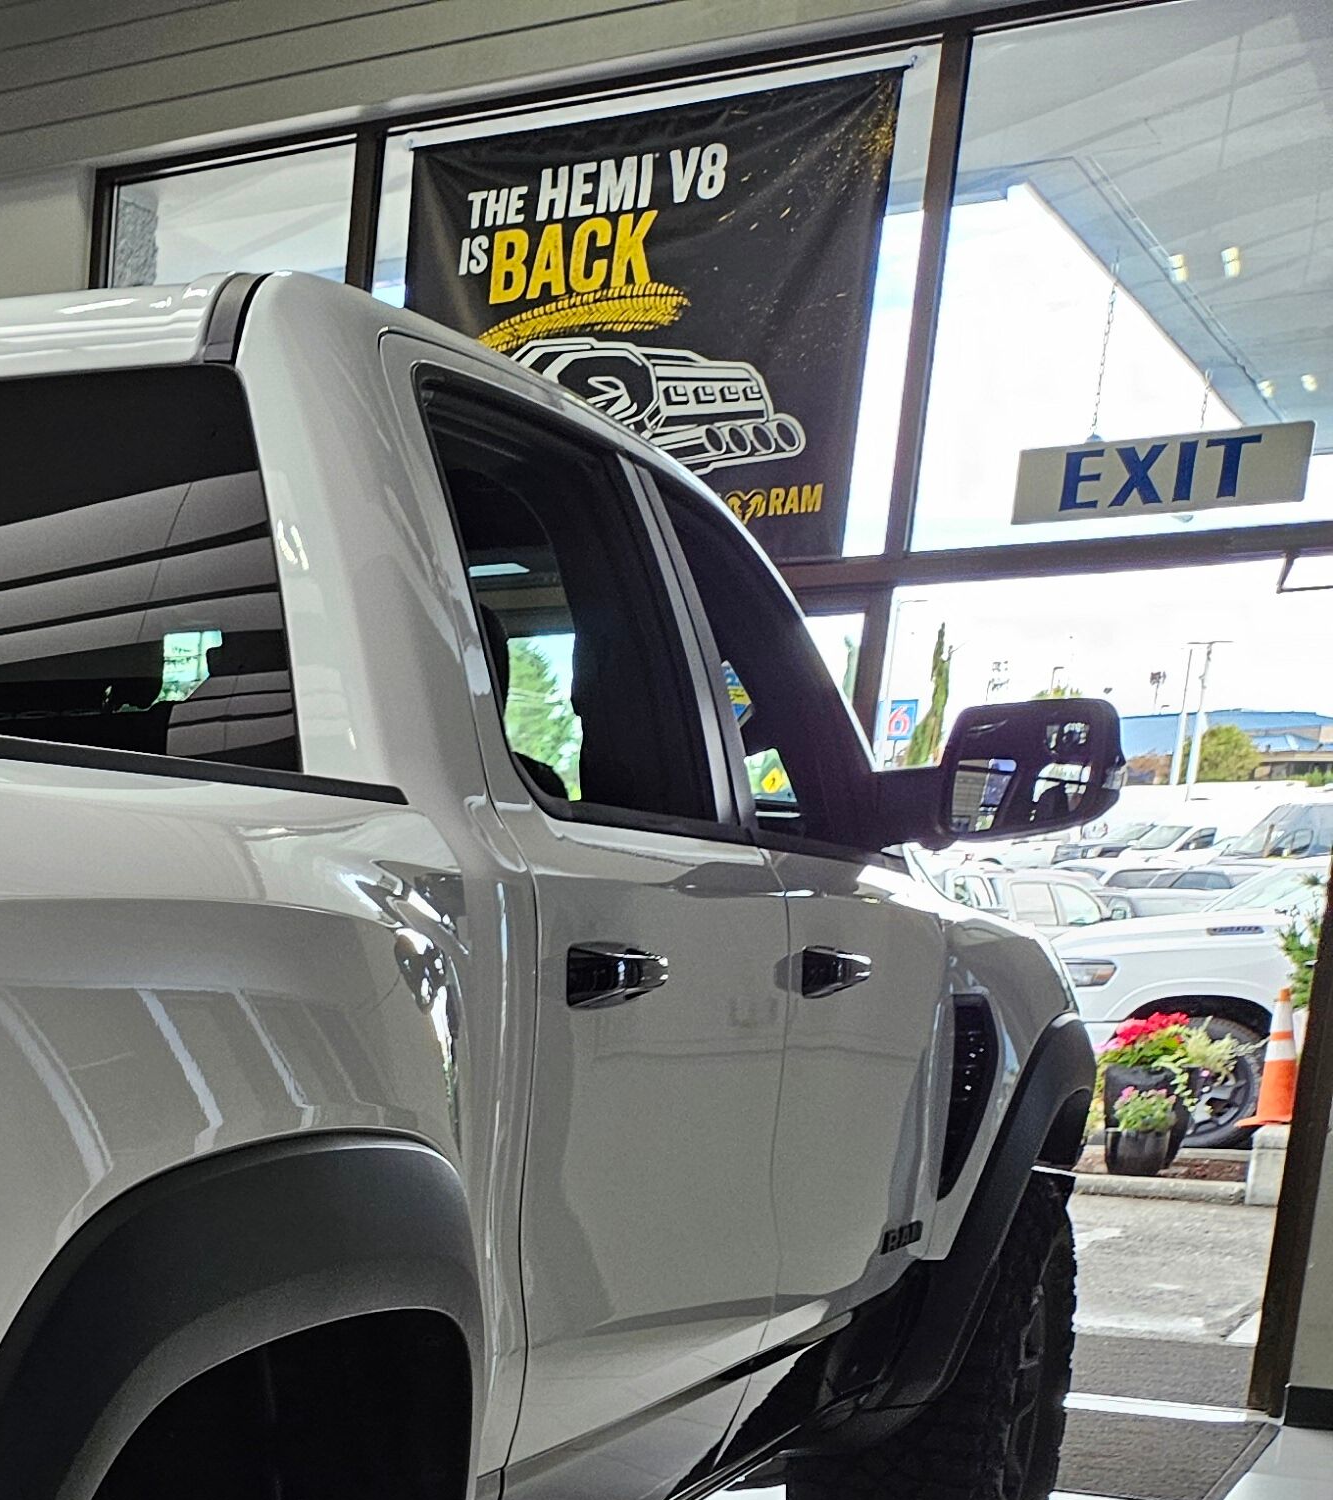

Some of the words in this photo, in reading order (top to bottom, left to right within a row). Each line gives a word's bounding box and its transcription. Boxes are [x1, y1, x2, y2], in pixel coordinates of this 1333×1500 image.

[467, 185, 529, 229] THE
[535, 153, 655, 222] HEMI
[669, 142, 728, 204] V8
[458, 235, 489, 276] IS
[488, 209, 659, 305] BACK
[767, 482, 824, 517] RAM
[1058, 433, 1264, 513] EXIT
[888, 704, 910, 737] 6
